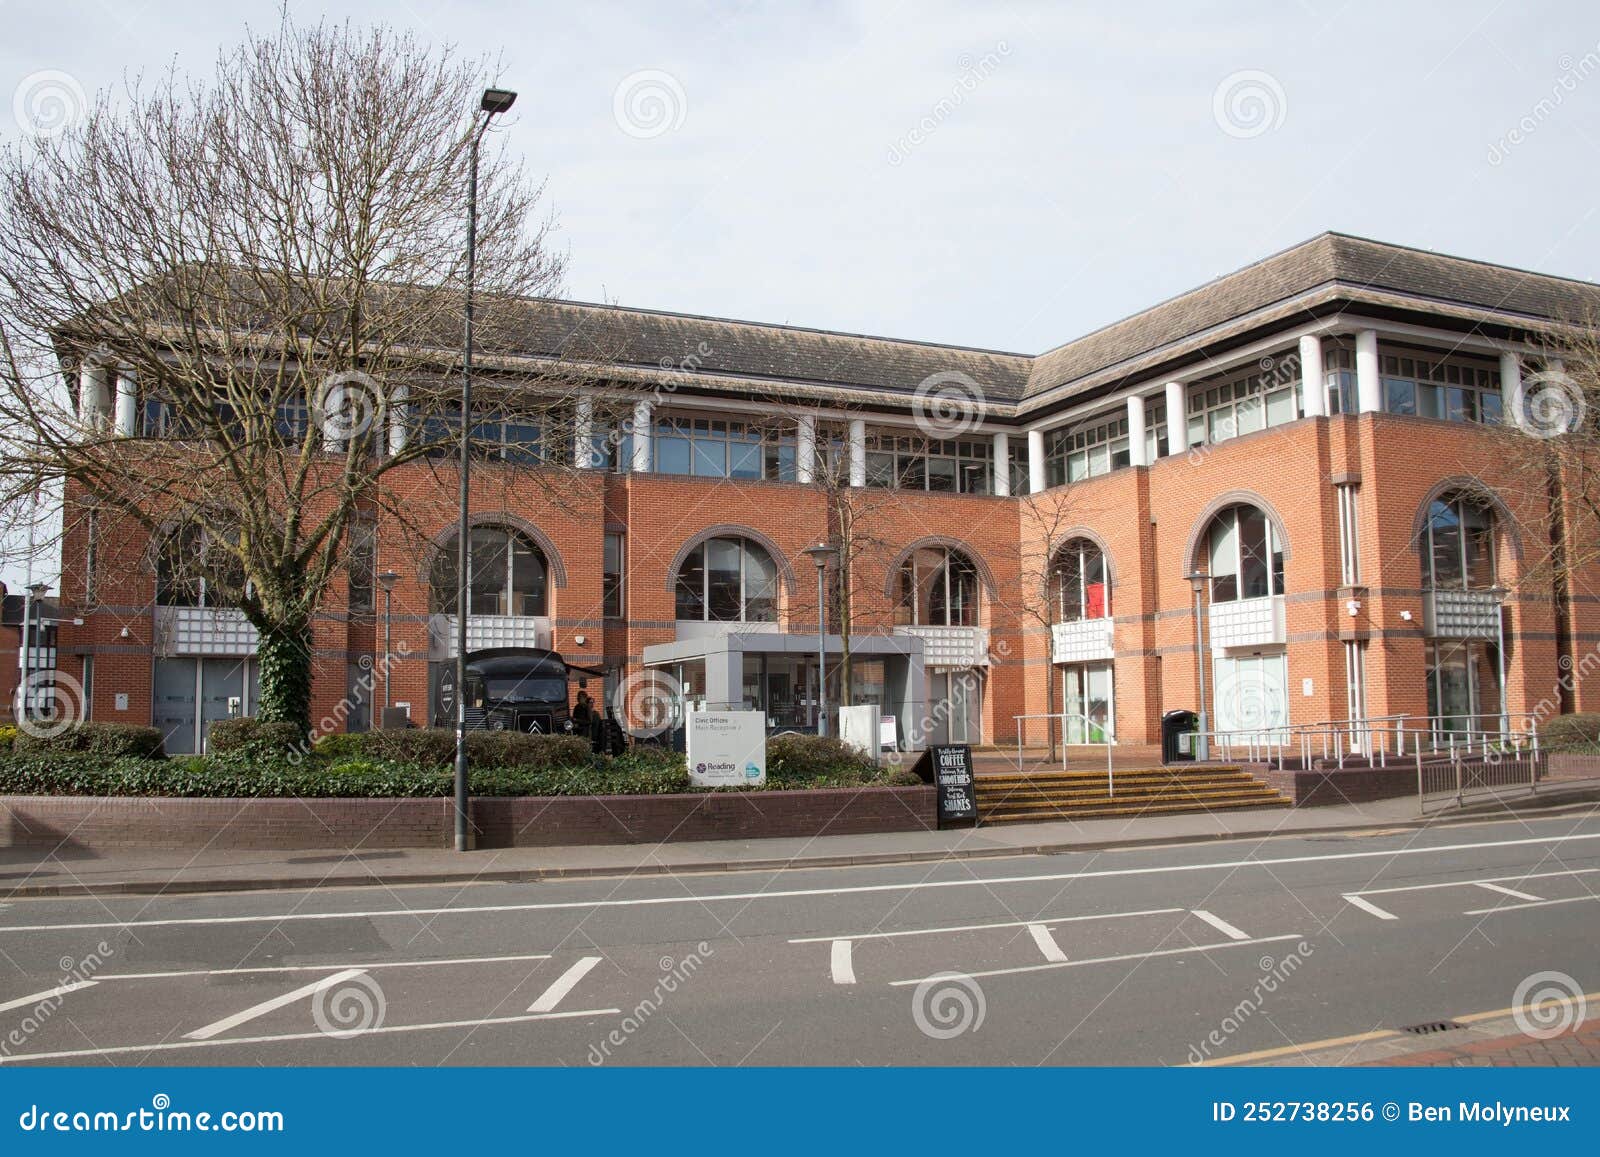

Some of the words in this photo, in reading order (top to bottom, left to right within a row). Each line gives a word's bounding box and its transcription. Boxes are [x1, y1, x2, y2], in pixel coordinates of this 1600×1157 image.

[940, 754, 965, 766] COFFEE
[707, 763, 735, 771] Reading
[944, 799, 971, 811] SHAKES
